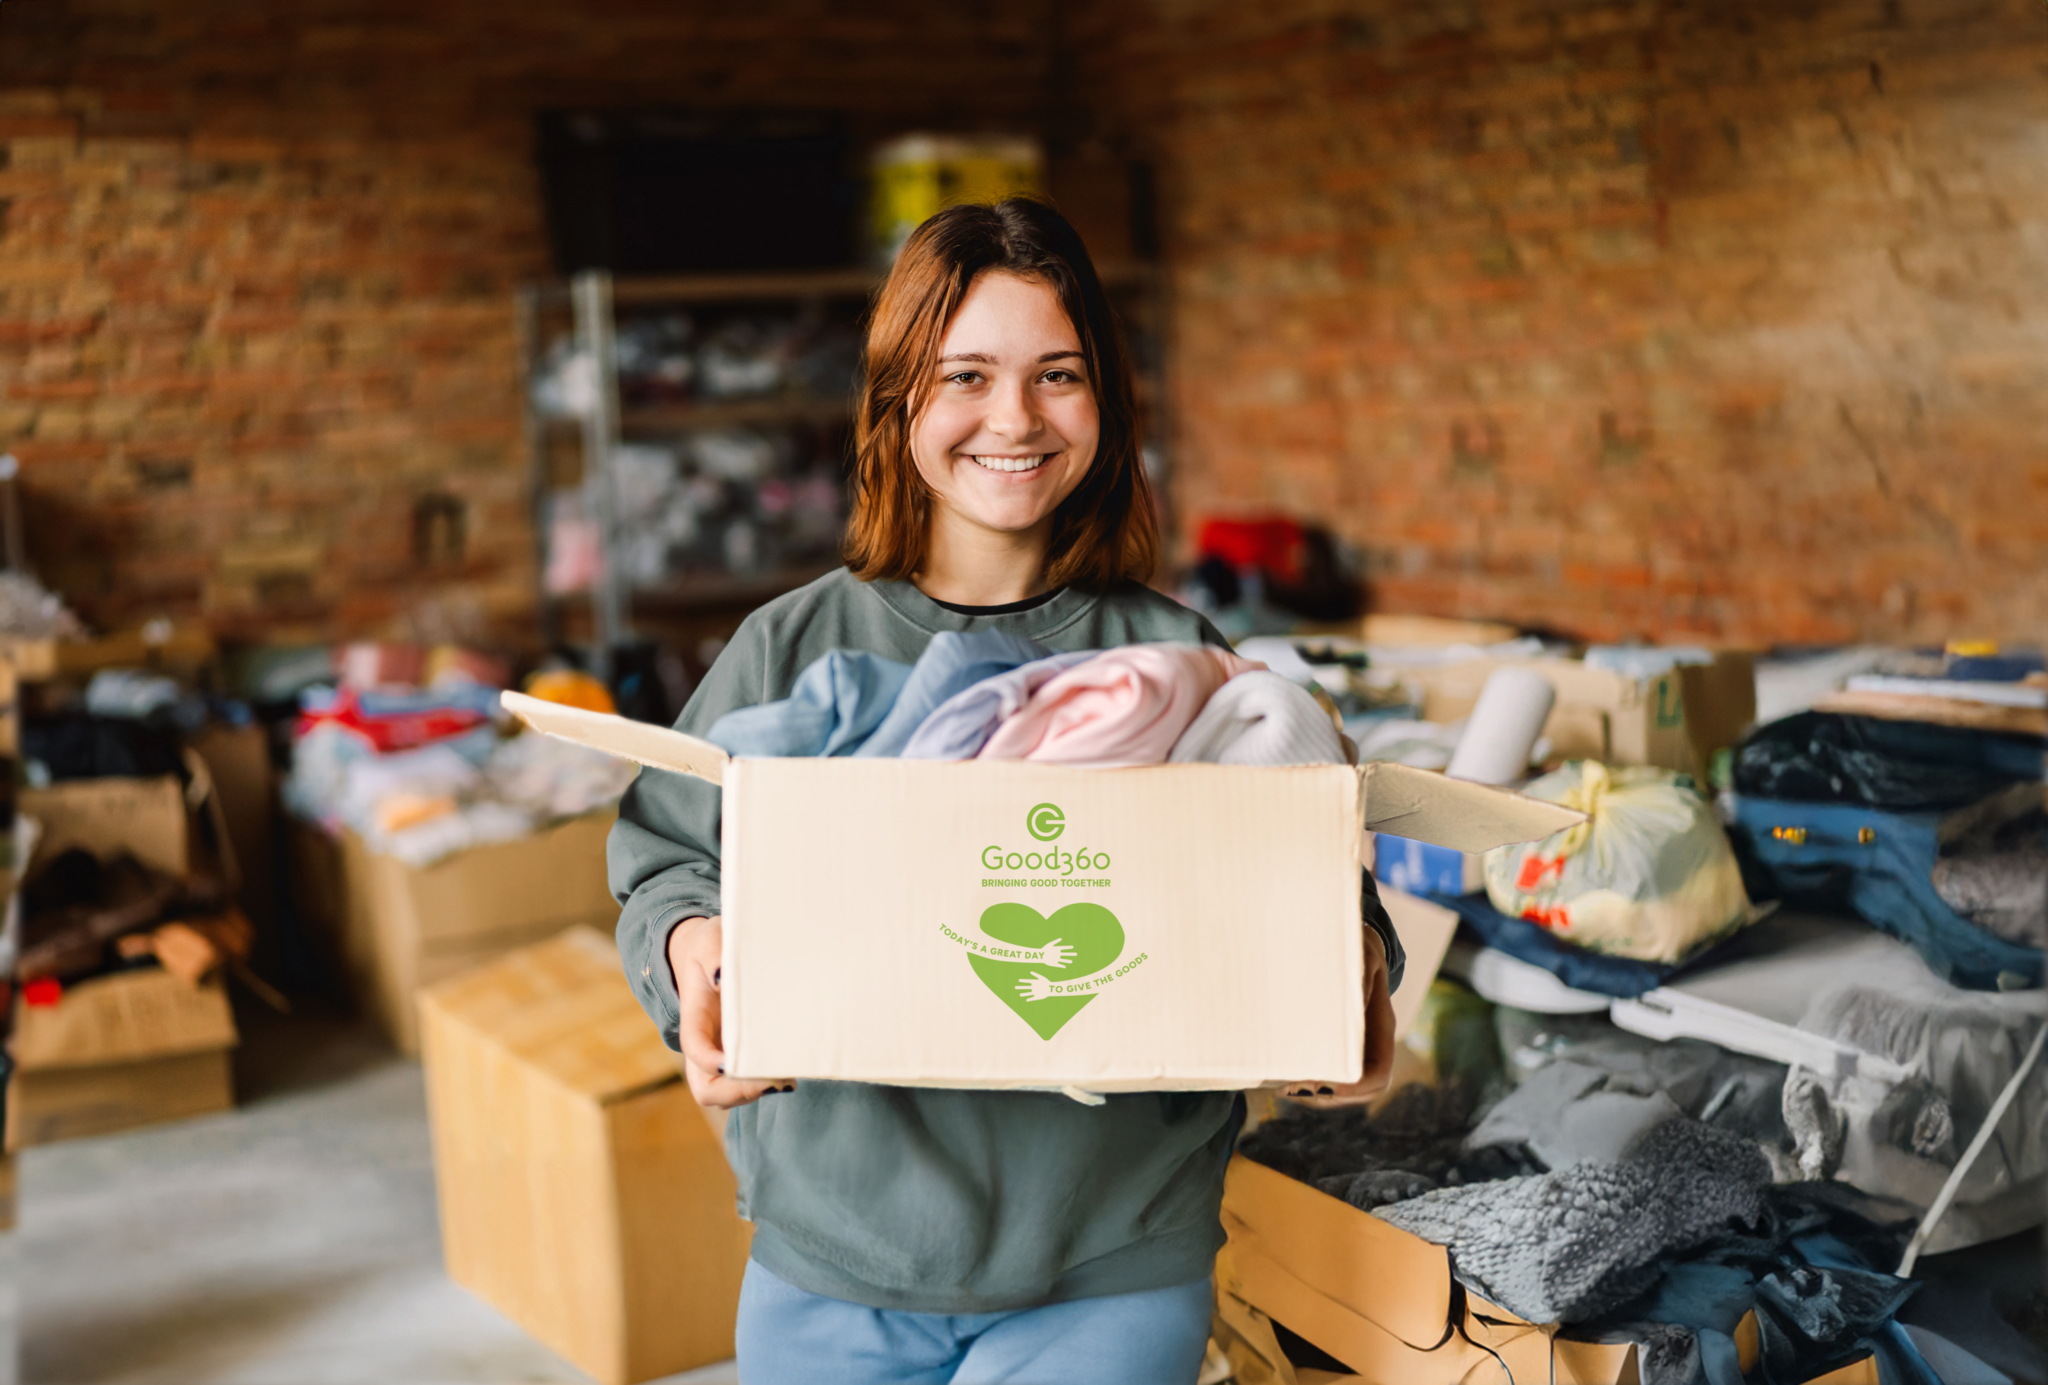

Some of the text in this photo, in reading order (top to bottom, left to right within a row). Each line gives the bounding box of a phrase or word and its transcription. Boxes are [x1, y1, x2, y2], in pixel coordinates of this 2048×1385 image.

[981, 845, 1111, 876] Good360
[981, 878, 1111, 887] BRINGING GOOD TOGETHER
[938, 923, 1045, 960] TODAY'S A GREAT DAY
[1049, 952, 1149, 993] TO GIVE THE GOODS
